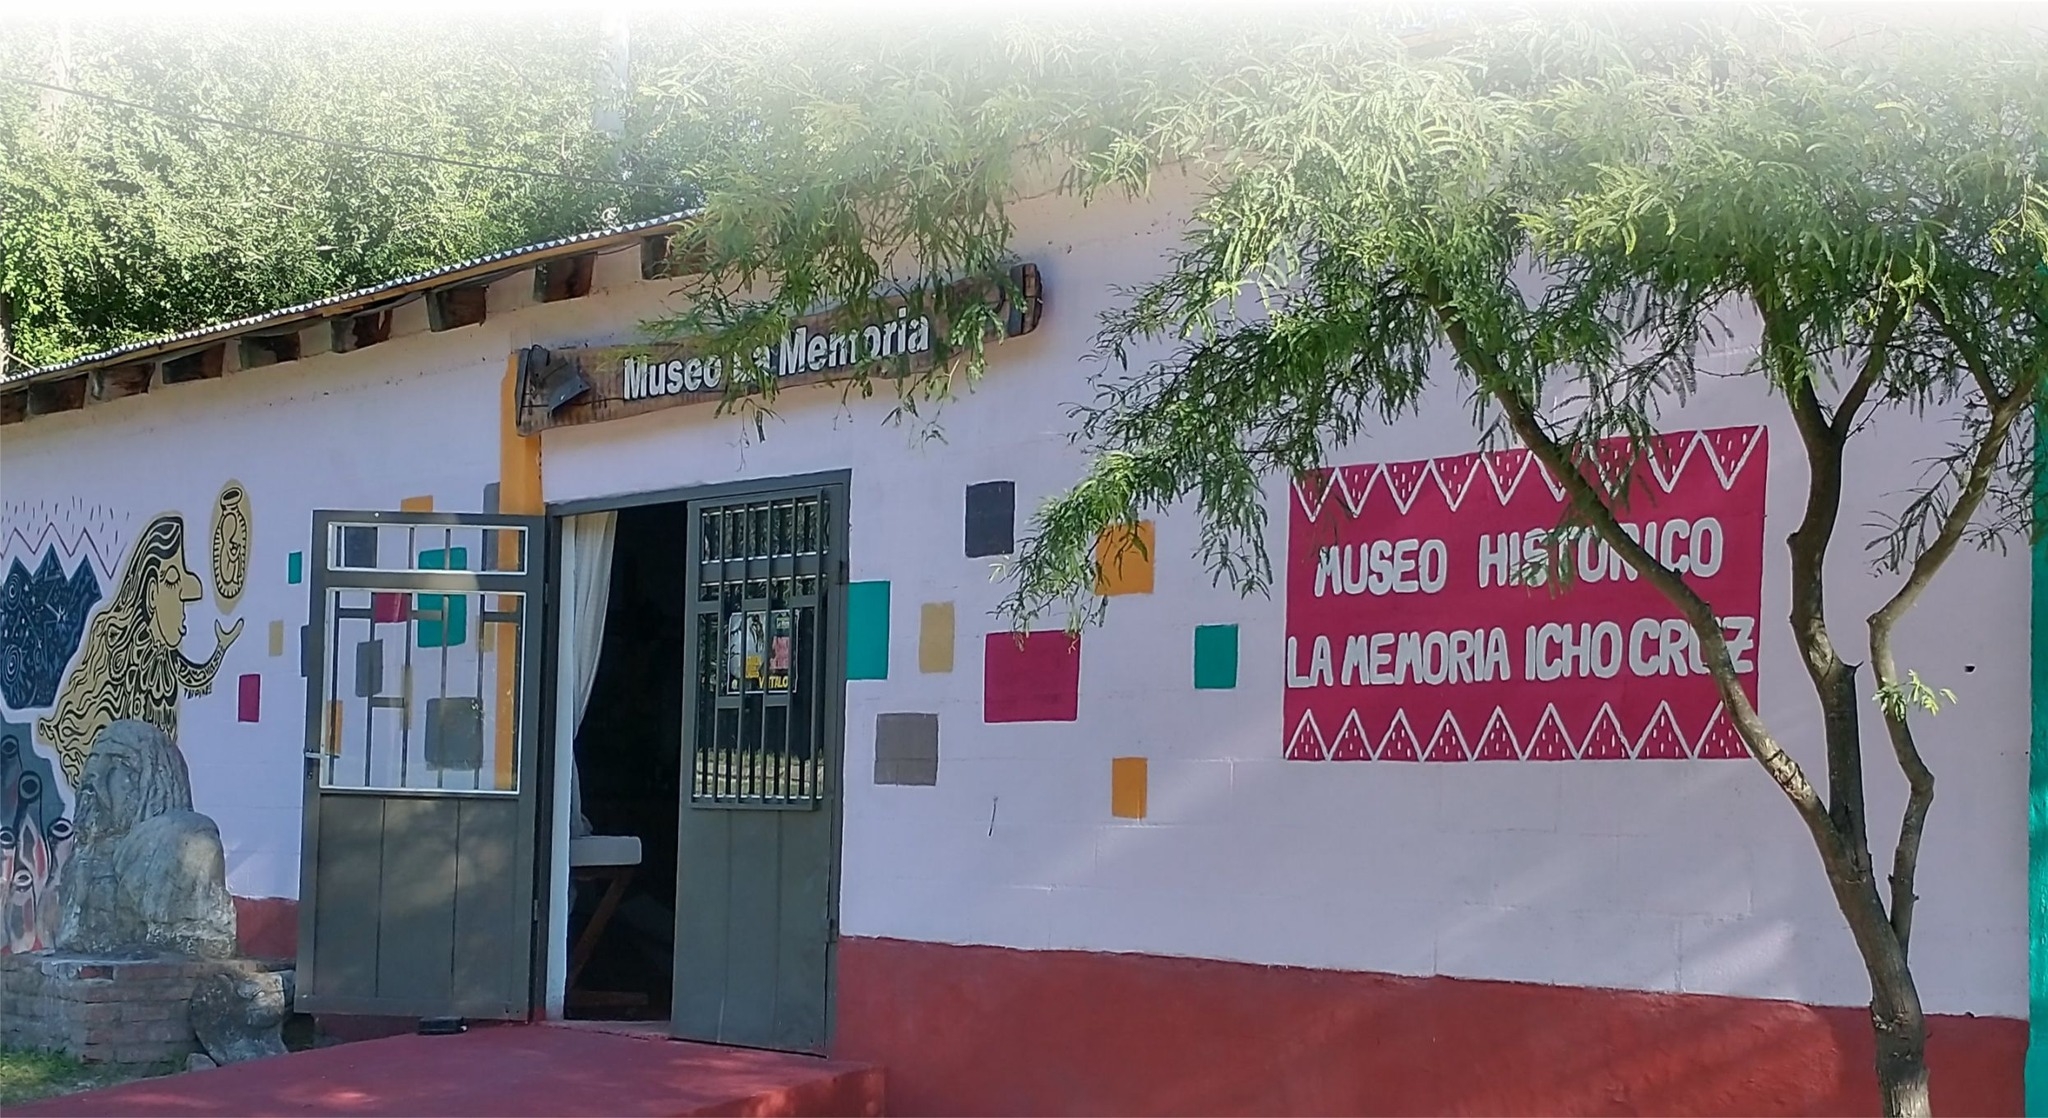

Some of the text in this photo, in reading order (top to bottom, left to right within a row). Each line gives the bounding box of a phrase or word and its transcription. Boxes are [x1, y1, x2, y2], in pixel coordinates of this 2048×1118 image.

[624, 354, 723, 400] Museo
[779, 307, 930, 376] Memoria
[1314, 538, 1448, 598] MUSEO
[1287, 635, 1334, 689] LA
[1341, 626, 1511, 686] MEMORIA
[1525, 620, 1623, 682] ICHO
